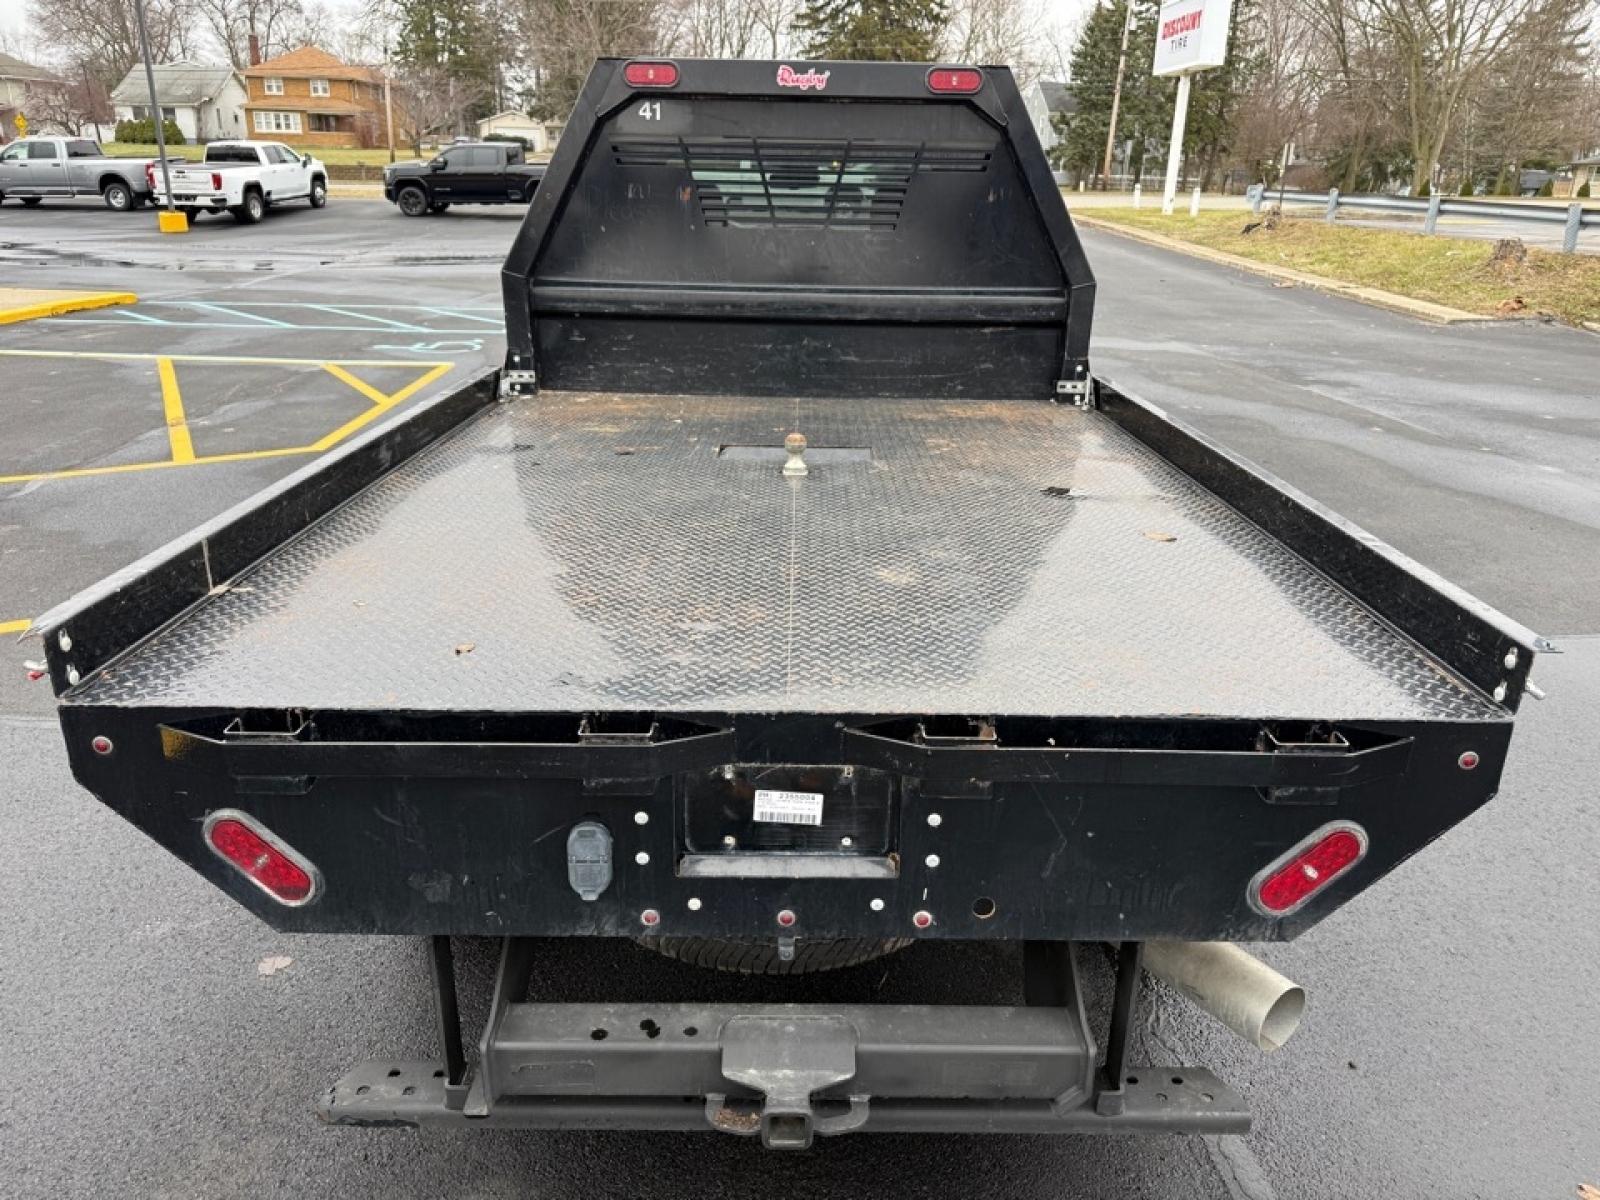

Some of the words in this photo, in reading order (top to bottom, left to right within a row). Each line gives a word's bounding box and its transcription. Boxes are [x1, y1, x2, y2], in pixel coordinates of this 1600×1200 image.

[1161, 9, 1202, 40] DISCOUNT
[1171, 36, 1188, 51] TIRE
[777, 64, 831, 91] Rugby
[638, 101, 661, 121] 41
